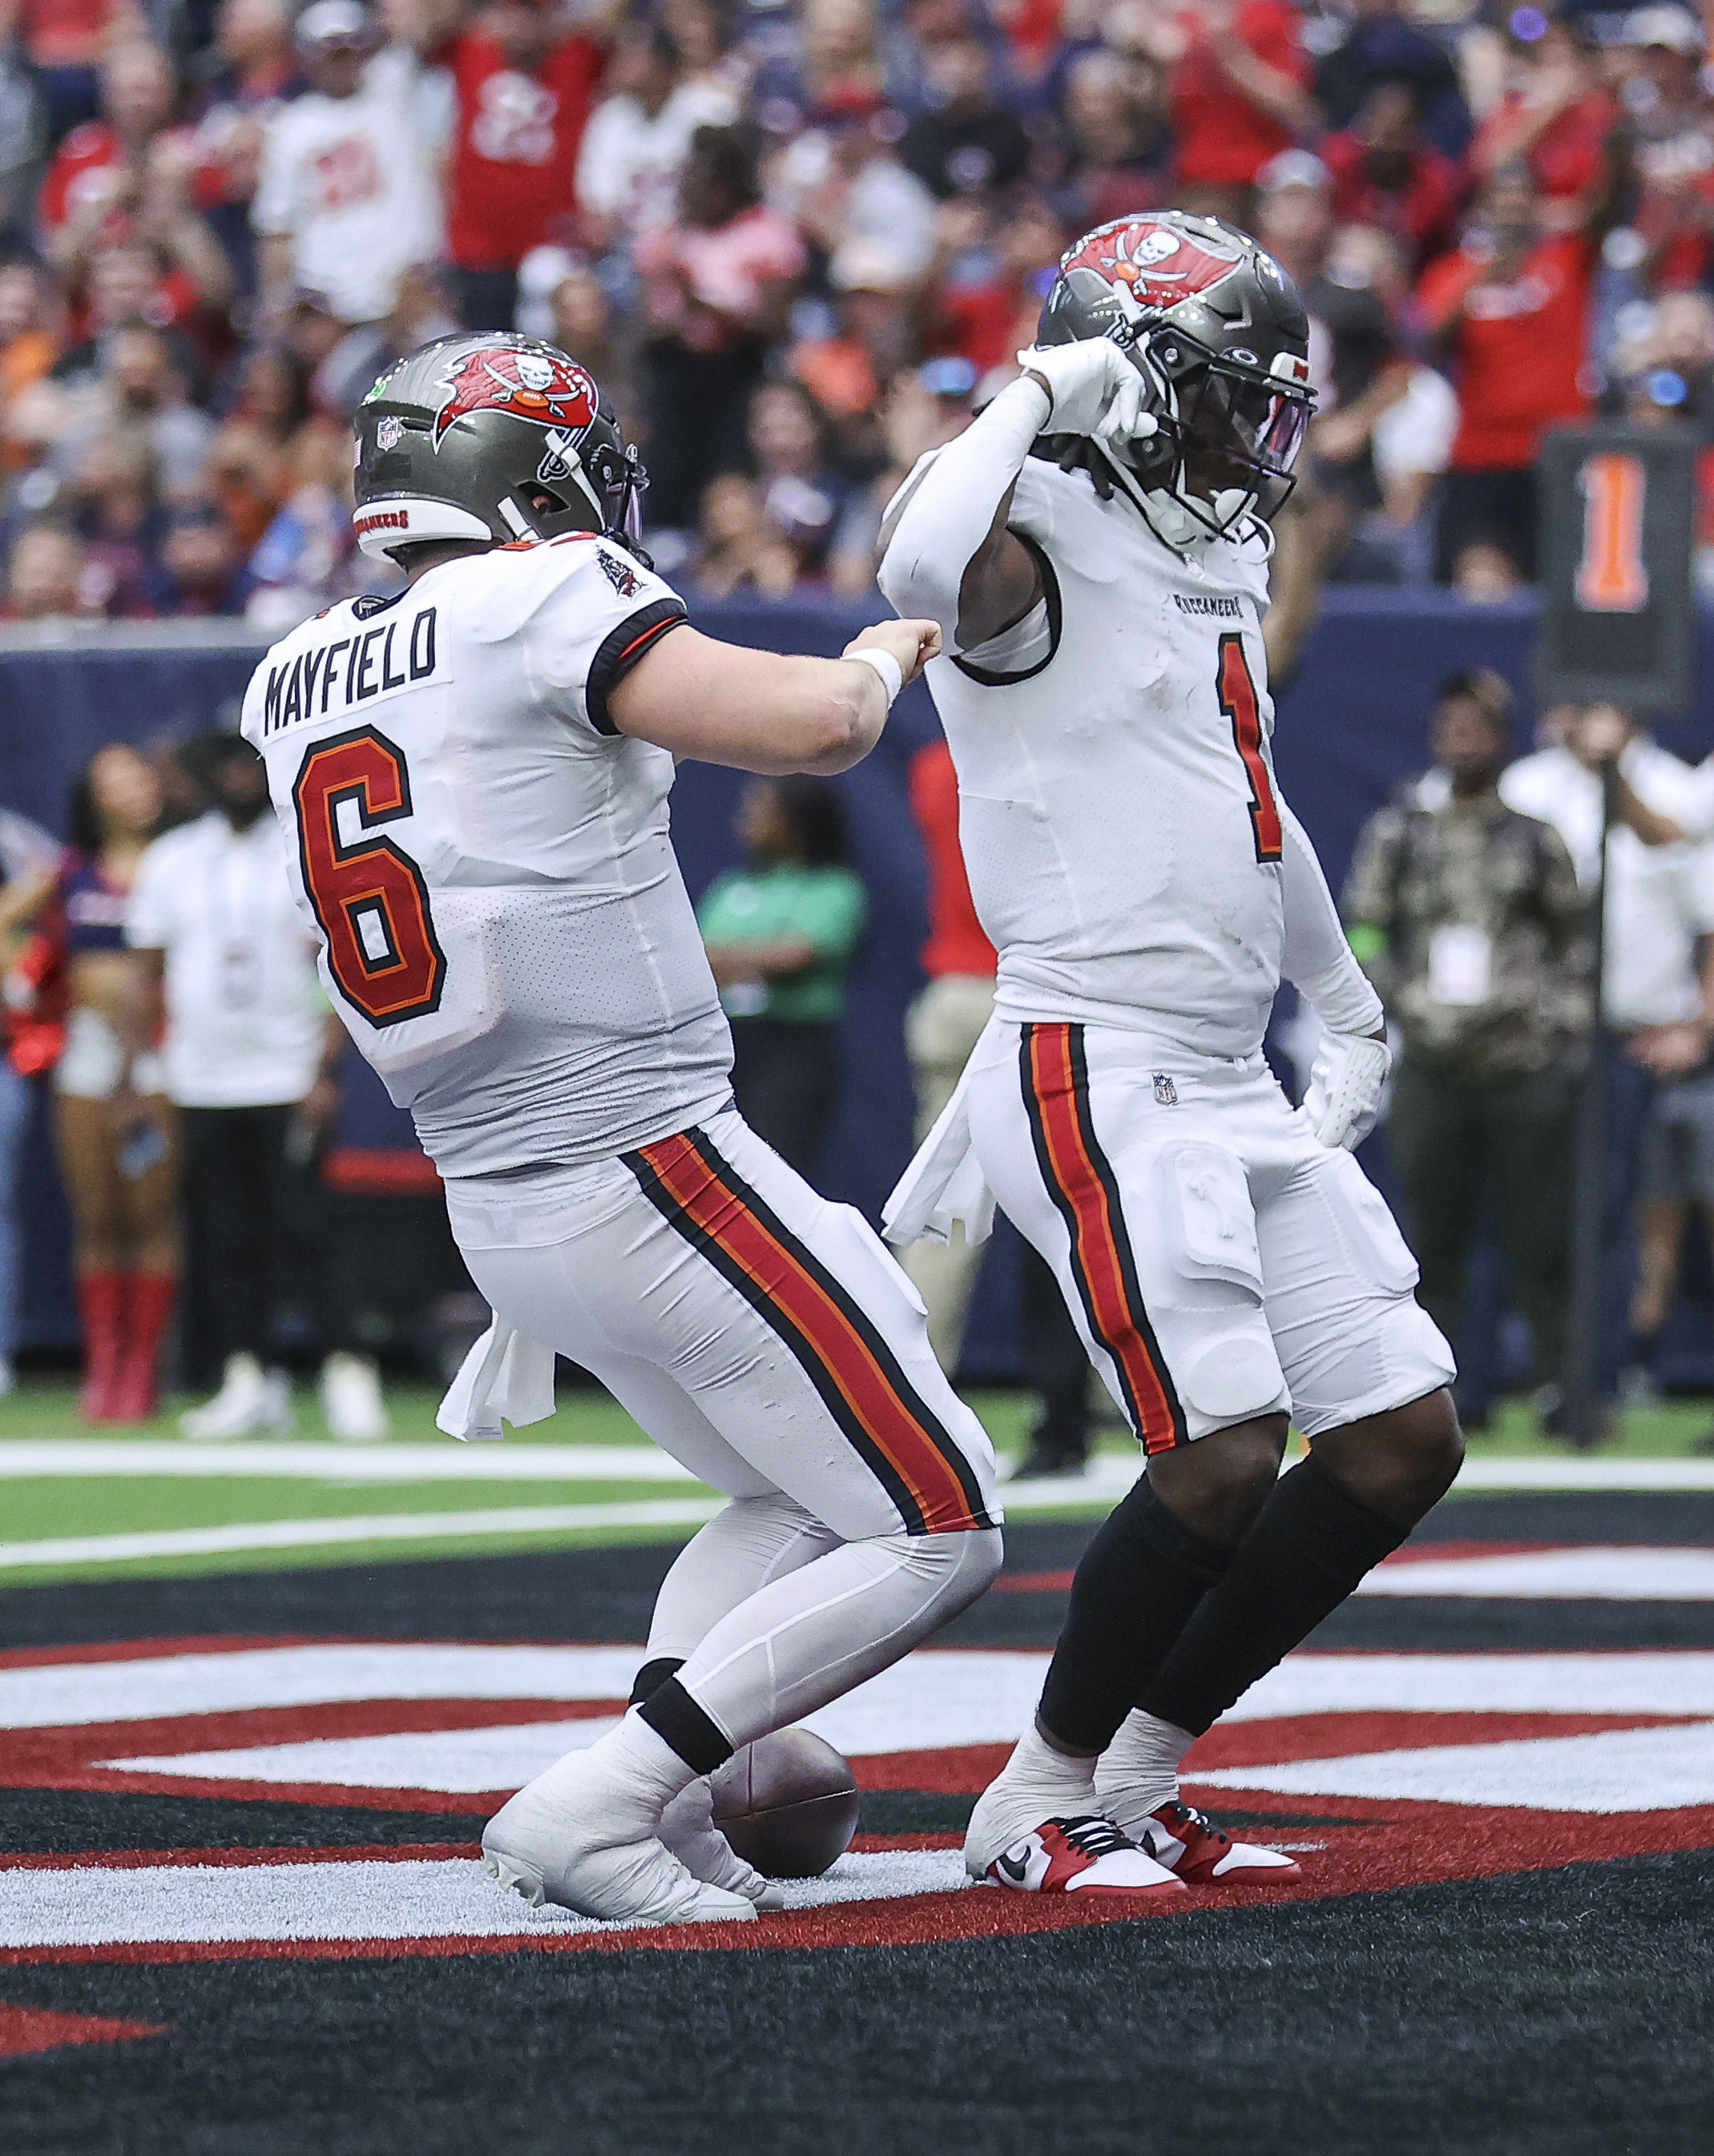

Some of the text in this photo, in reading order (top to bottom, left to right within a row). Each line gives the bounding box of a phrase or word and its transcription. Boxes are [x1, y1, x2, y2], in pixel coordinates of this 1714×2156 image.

[1575, 452, 1648, 612] 1
[264, 607, 437, 737] MAYFIELD
[1216, 631, 1282, 863] 1
[292, 723, 447, 1030] 6
[1157, 1086, 1176, 1102] NFL
